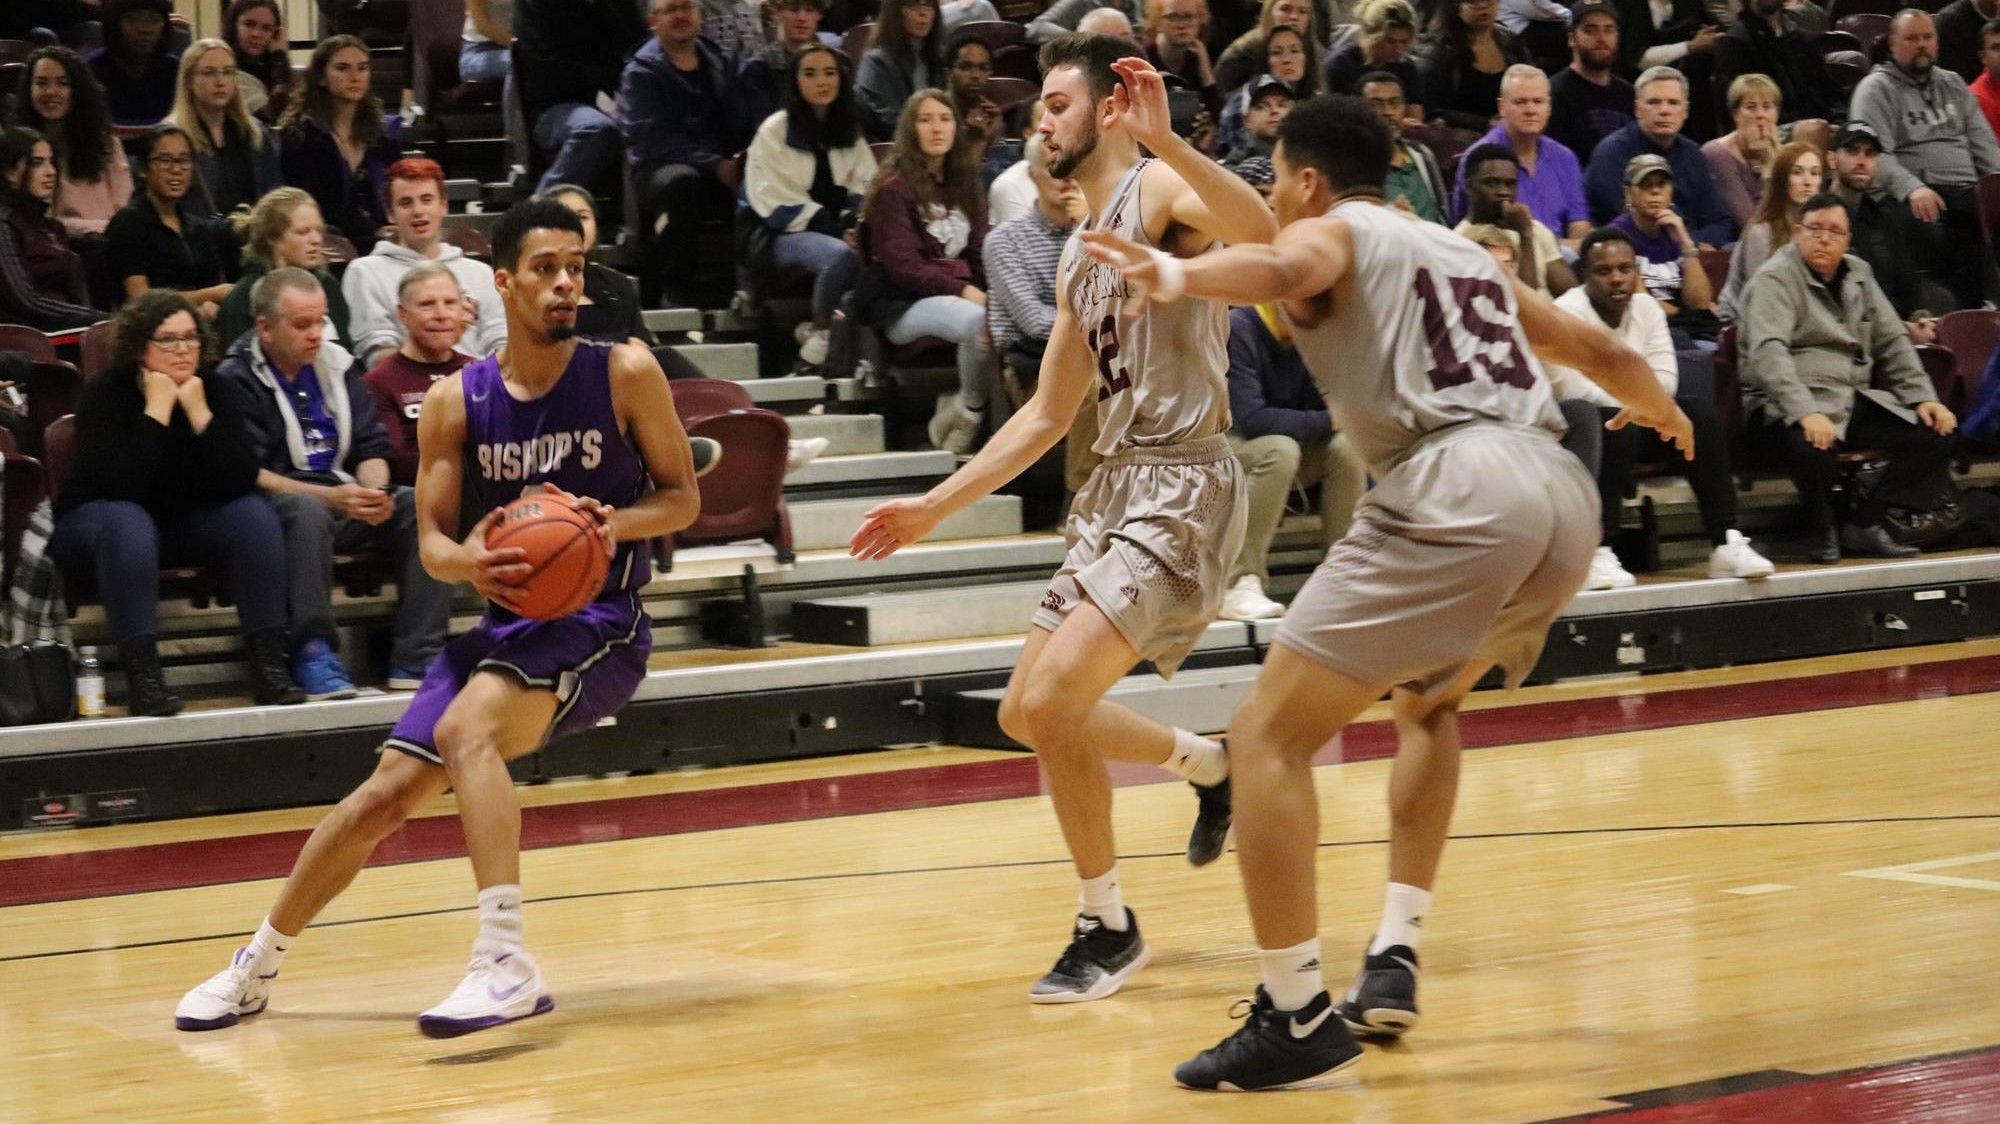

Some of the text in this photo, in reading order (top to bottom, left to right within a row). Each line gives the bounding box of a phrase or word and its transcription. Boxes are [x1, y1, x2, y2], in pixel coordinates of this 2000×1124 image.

[1088, 315, 1132, 402] 12
[1414, 267, 1536, 392] 15
[478, 429, 602, 481] BISHOP'S
